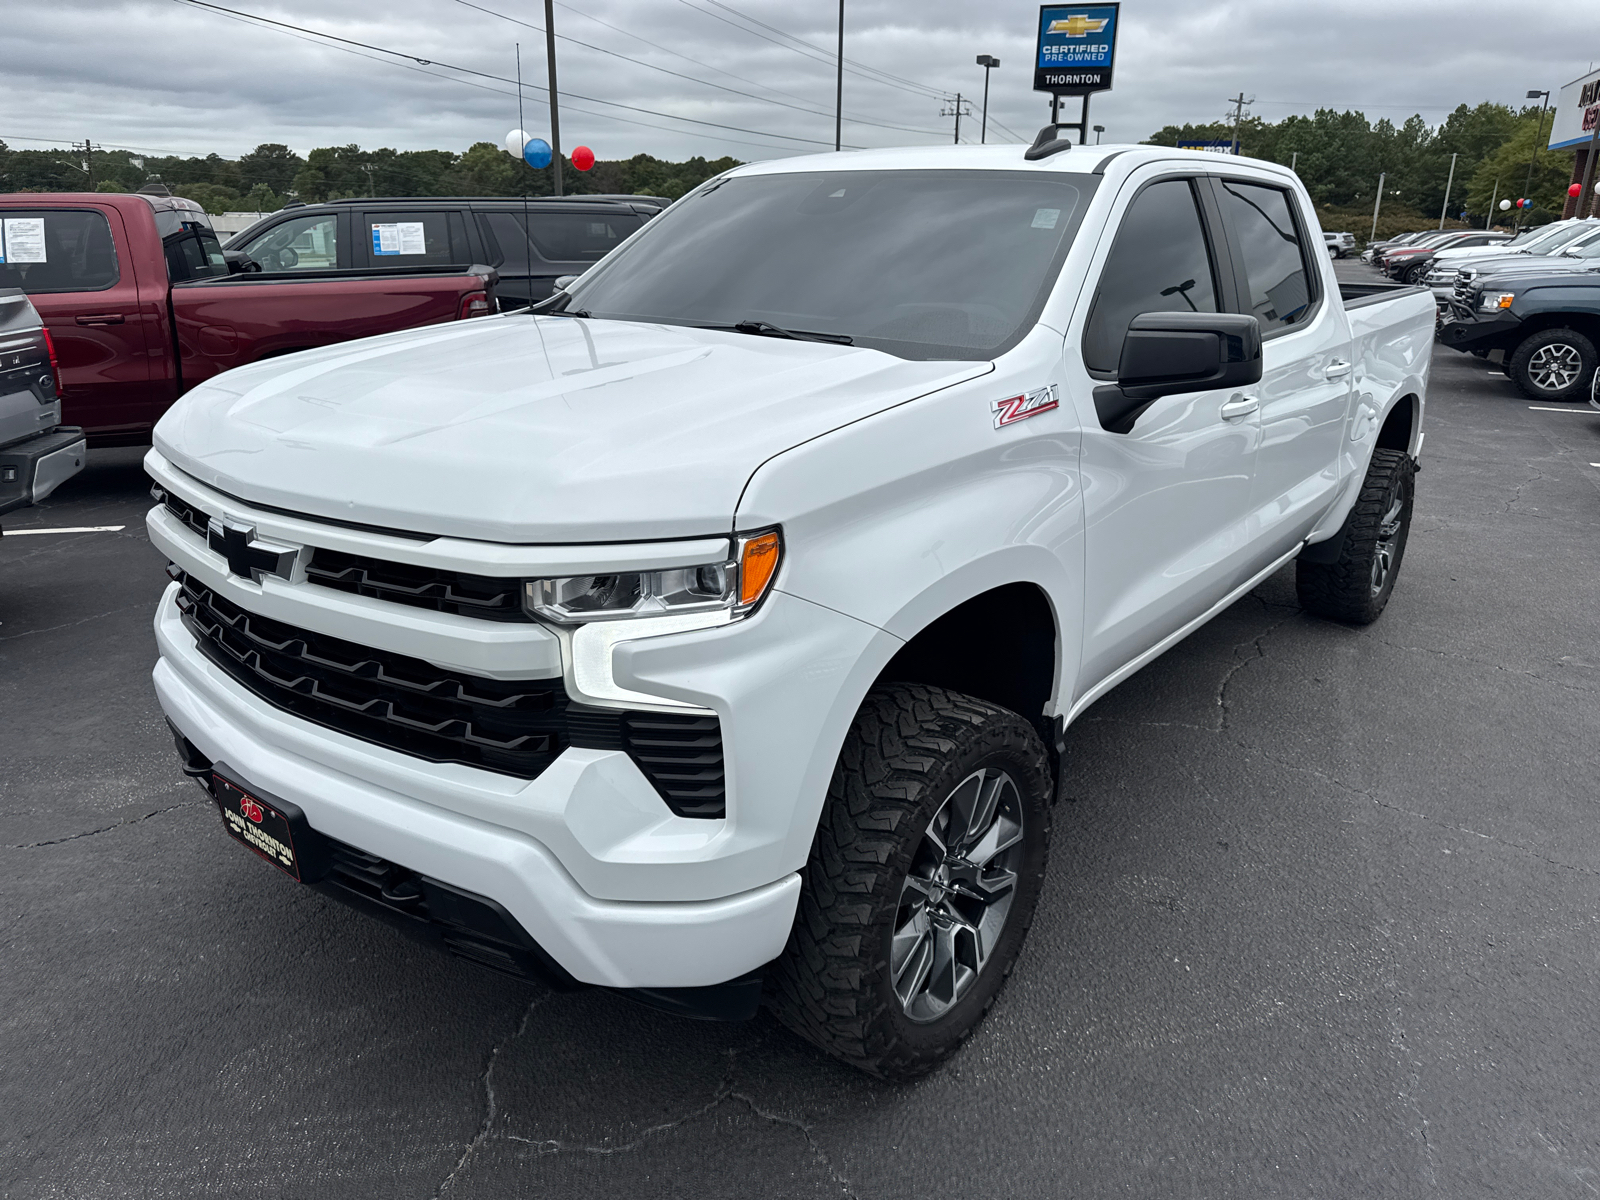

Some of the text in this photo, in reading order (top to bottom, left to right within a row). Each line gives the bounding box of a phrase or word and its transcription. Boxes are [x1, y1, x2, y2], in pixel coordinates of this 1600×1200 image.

[1042, 44, 1109, 53] CERTIFIED
[1044, 53, 1105, 62] PRE-OWNED
[1045, 74, 1101, 85] THORNTON
[990, 384, 1060, 430] Z71
[224, 807, 247, 830] JOHN
[246, 821, 294, 861] THORNTON
[243, 830, 277, 858] CHEVROLET
